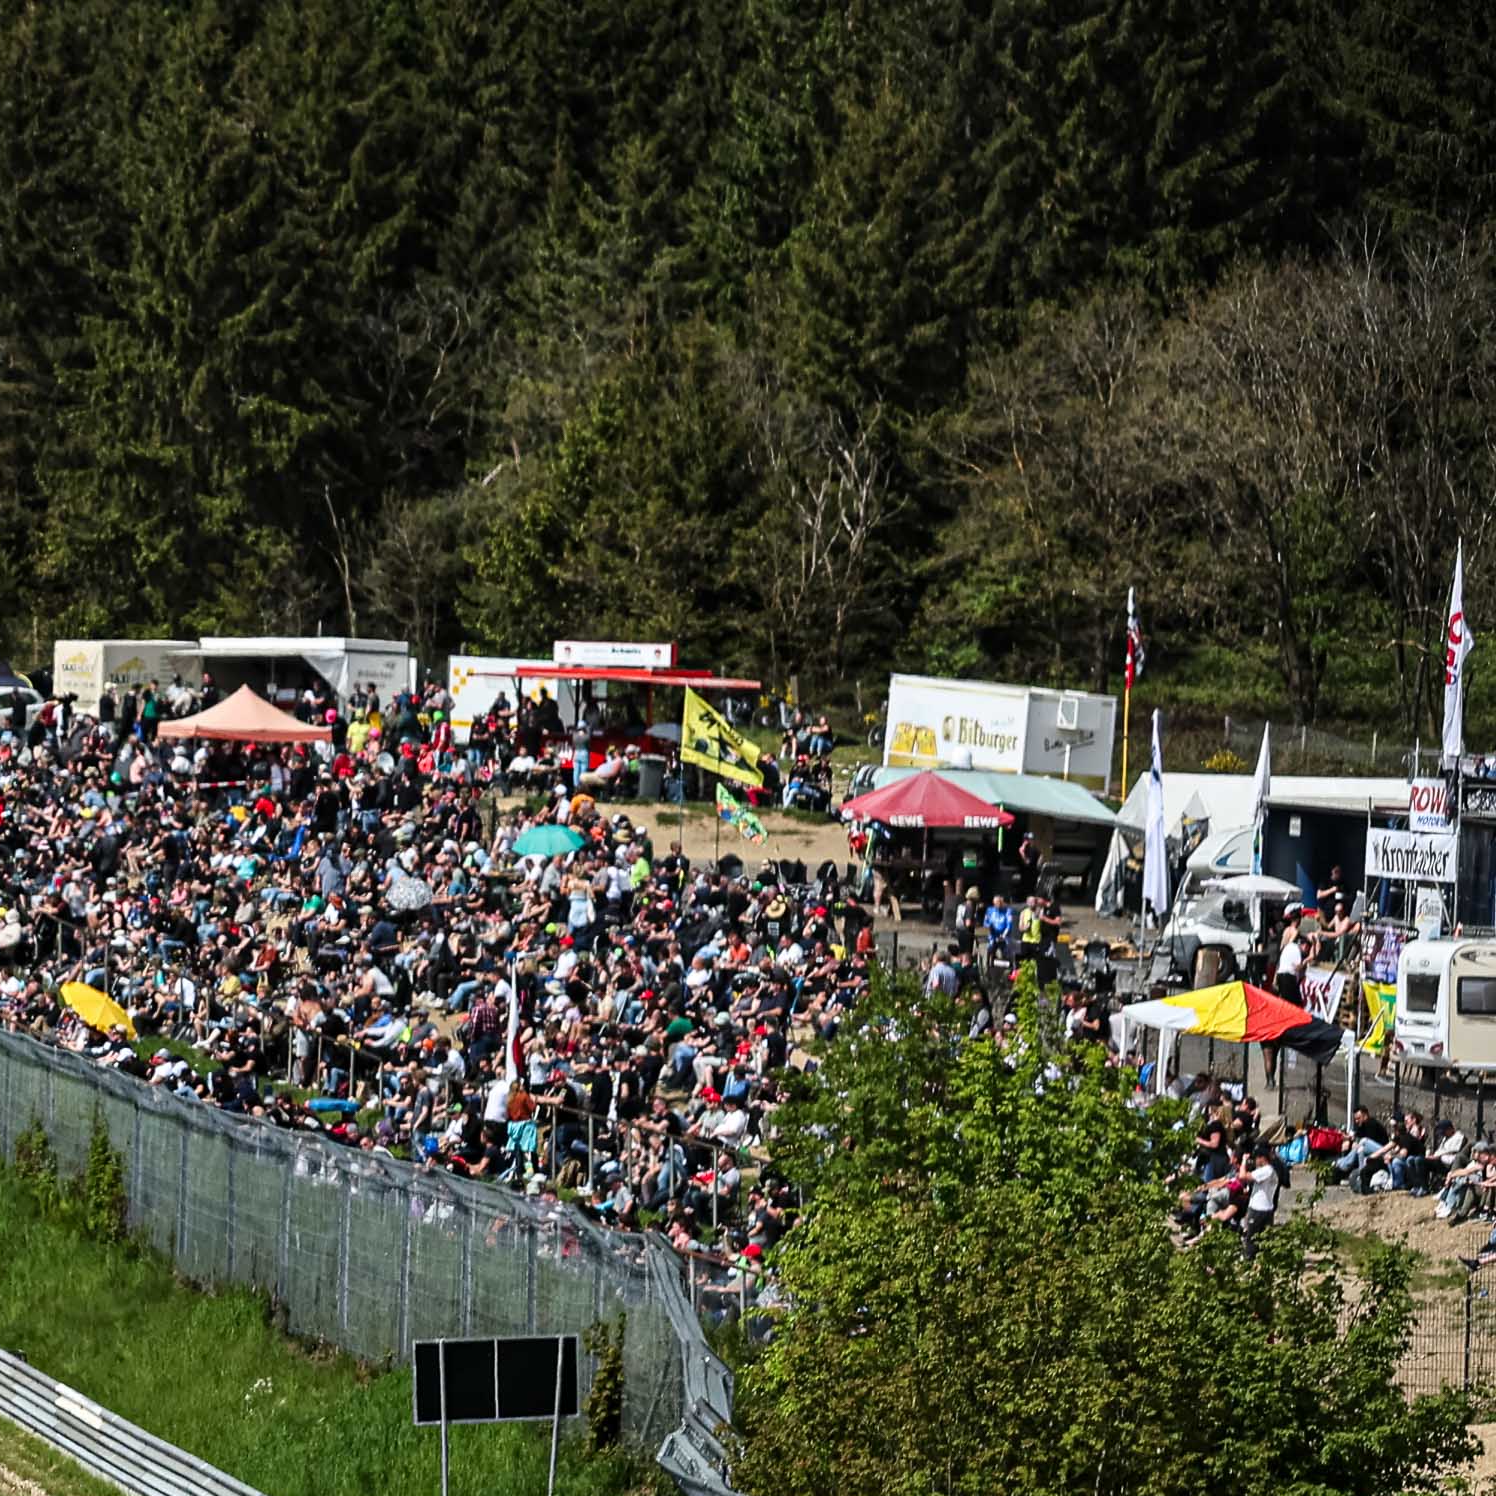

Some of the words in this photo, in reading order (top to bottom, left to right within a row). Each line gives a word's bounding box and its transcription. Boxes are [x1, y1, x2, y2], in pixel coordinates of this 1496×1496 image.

[958, 716, 1019, 755] Bitburger
[1409, 785, 1451, 816] ROW
[1381, 835, 1449, 877] Krombacher
